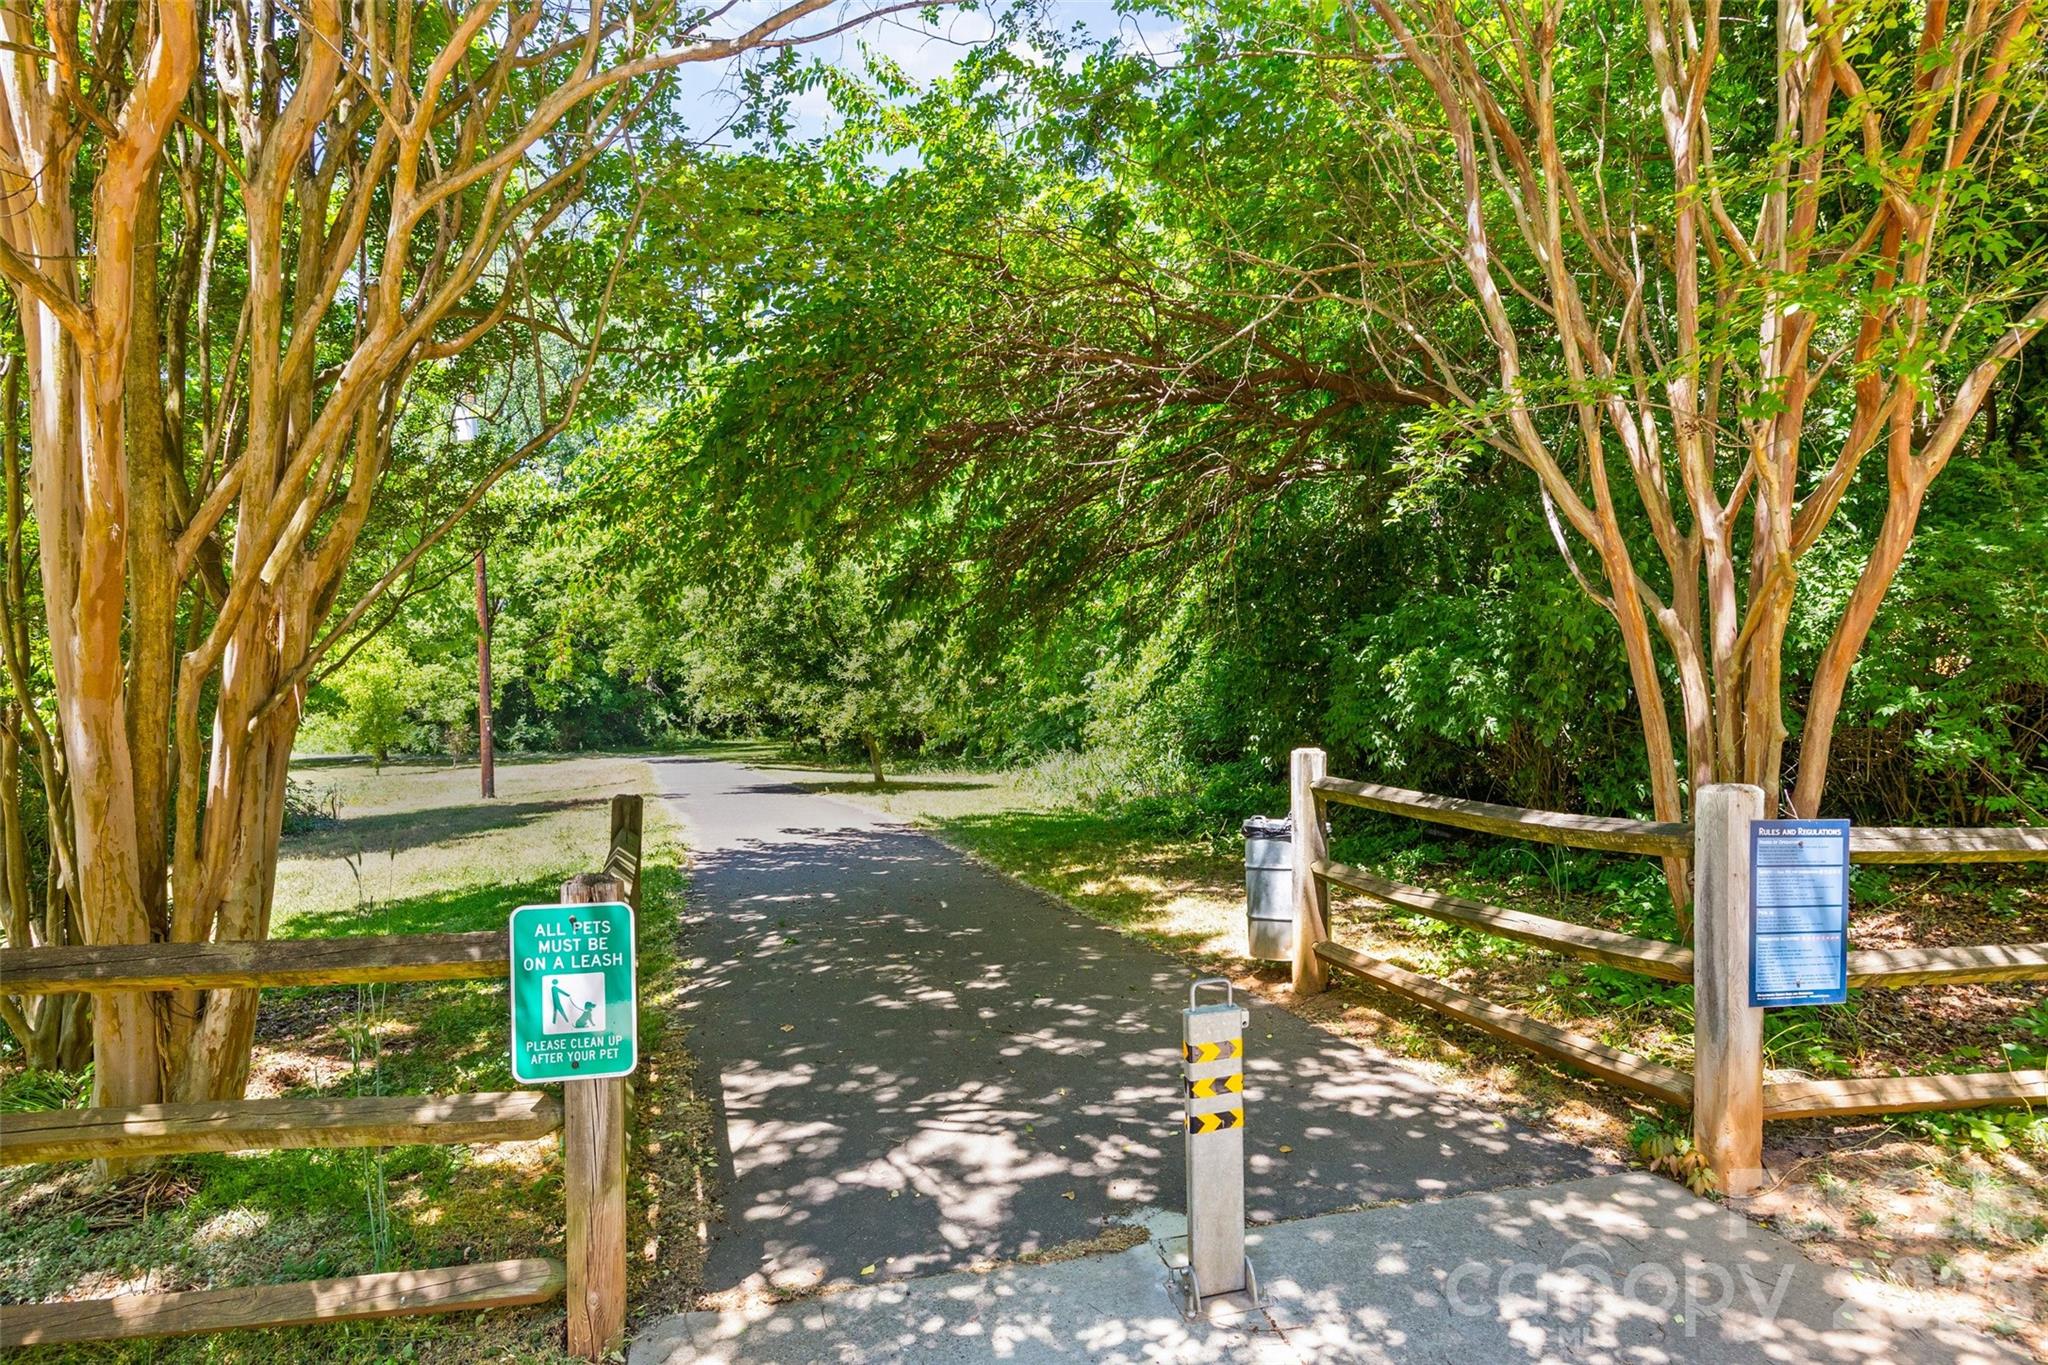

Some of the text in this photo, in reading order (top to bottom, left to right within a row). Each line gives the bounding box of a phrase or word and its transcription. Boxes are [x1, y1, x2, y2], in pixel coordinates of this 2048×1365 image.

[1758, 827, 1781, 836] RULES
[1797, 827, 1842, 836] REGULATIONS
[534, 920, 612, 938] ALL PETS
[538, 937, 609, 954] MUST BE
[523, 953, 624, 972] ON A LEASH
[525, 1035, 623, 1052] PLEASE CLEAN UP
[530, 1047, 619, 1065] AFTER YOUR PET
